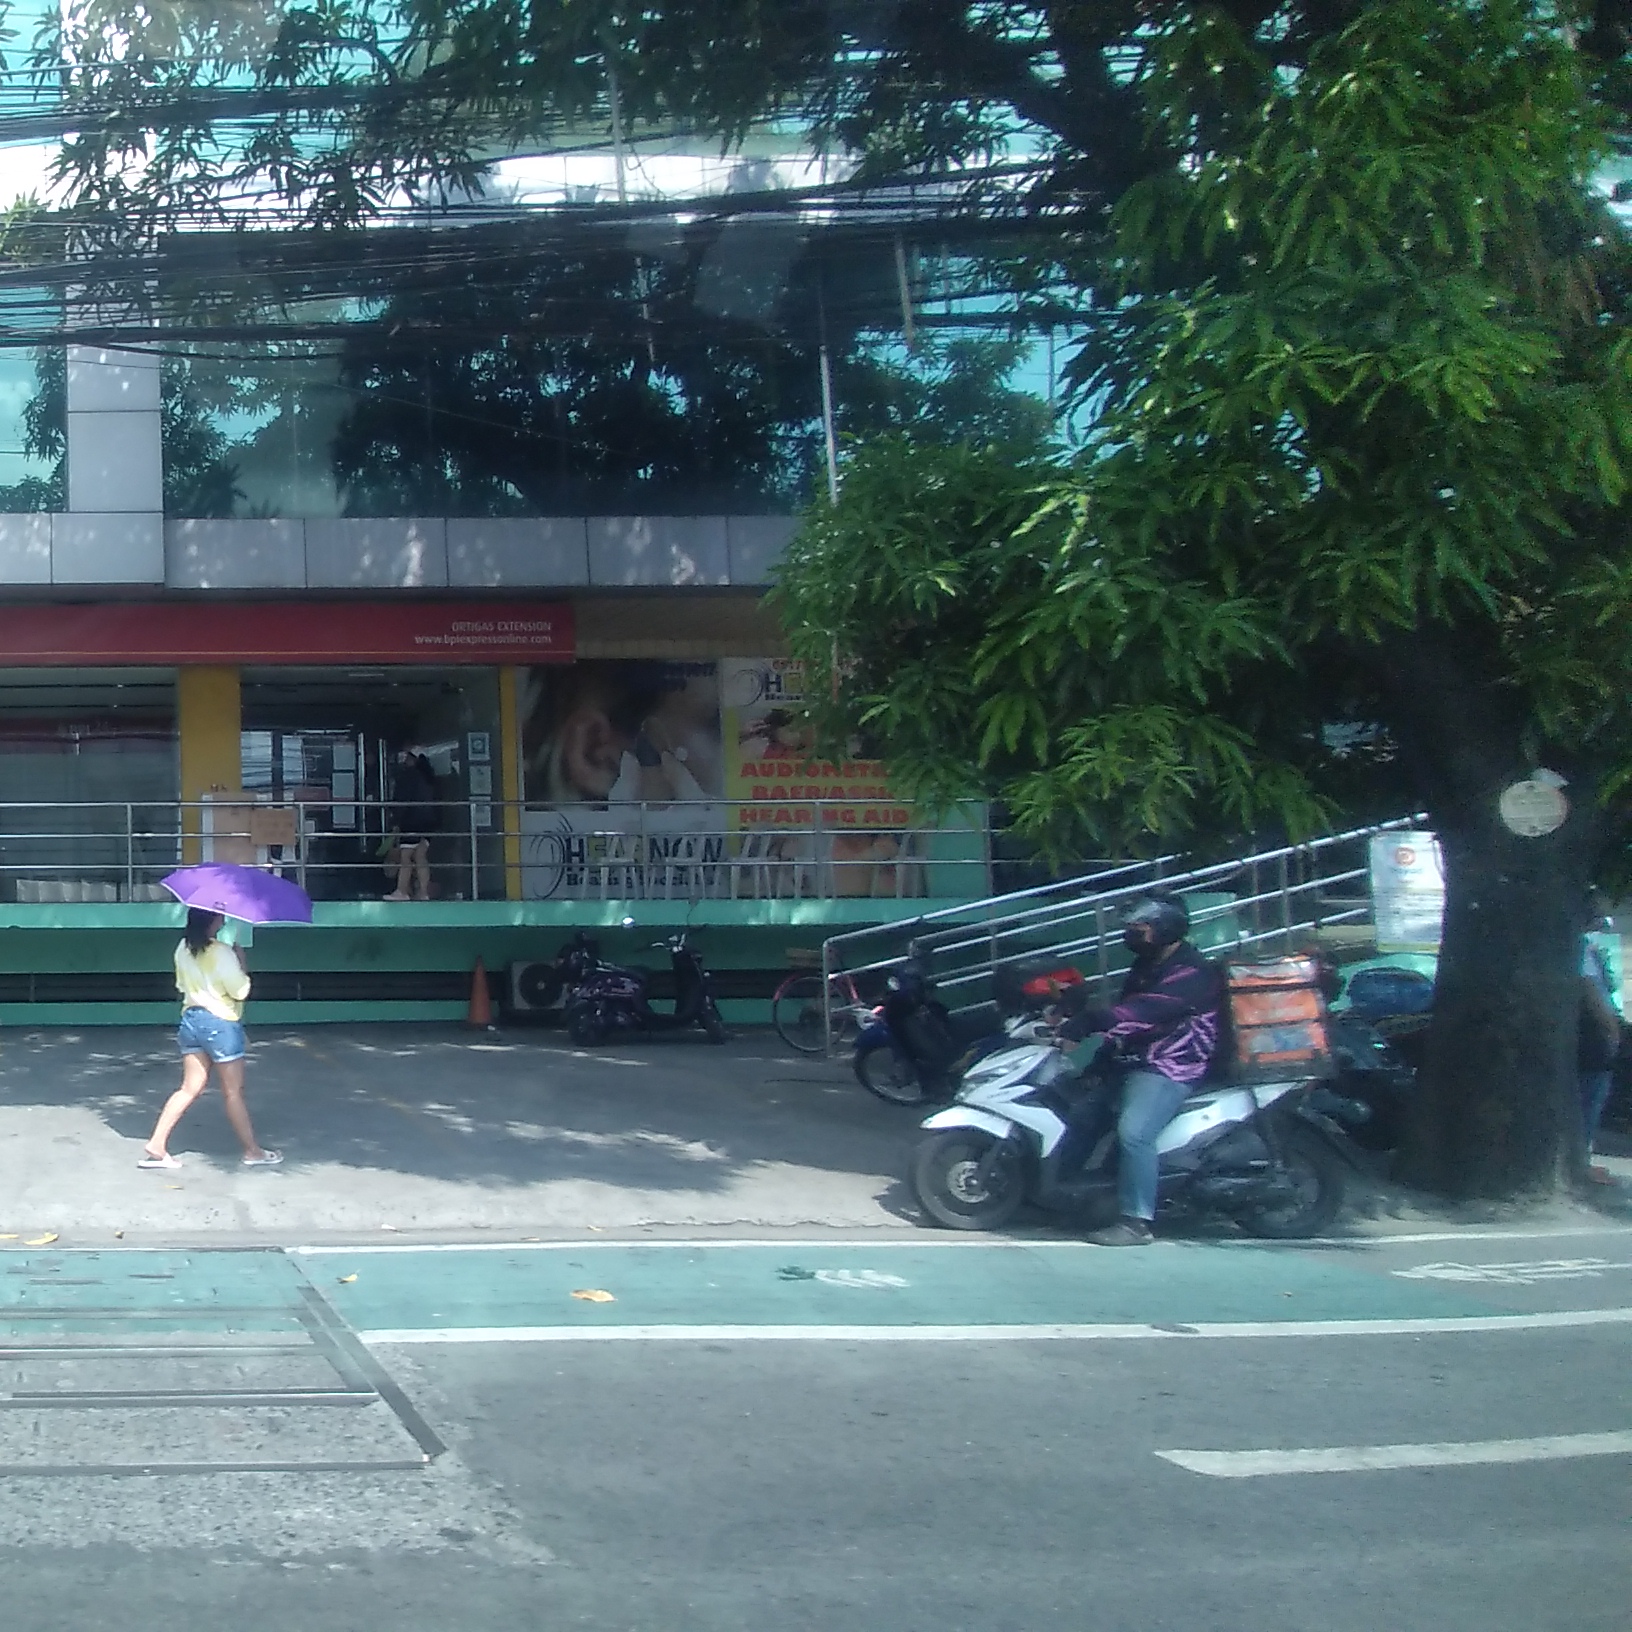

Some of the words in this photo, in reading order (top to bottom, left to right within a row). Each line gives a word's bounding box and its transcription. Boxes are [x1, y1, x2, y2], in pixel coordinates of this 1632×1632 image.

[451, 621, 494, 632] ORTIGAS
[497, 621, 552, 632] EXTENSION
[414, 634, 552, 646] www.bpiexpressonline.com
[739, 808, 856, 824] HEARNG
[863, 808, 910, 824] AID
